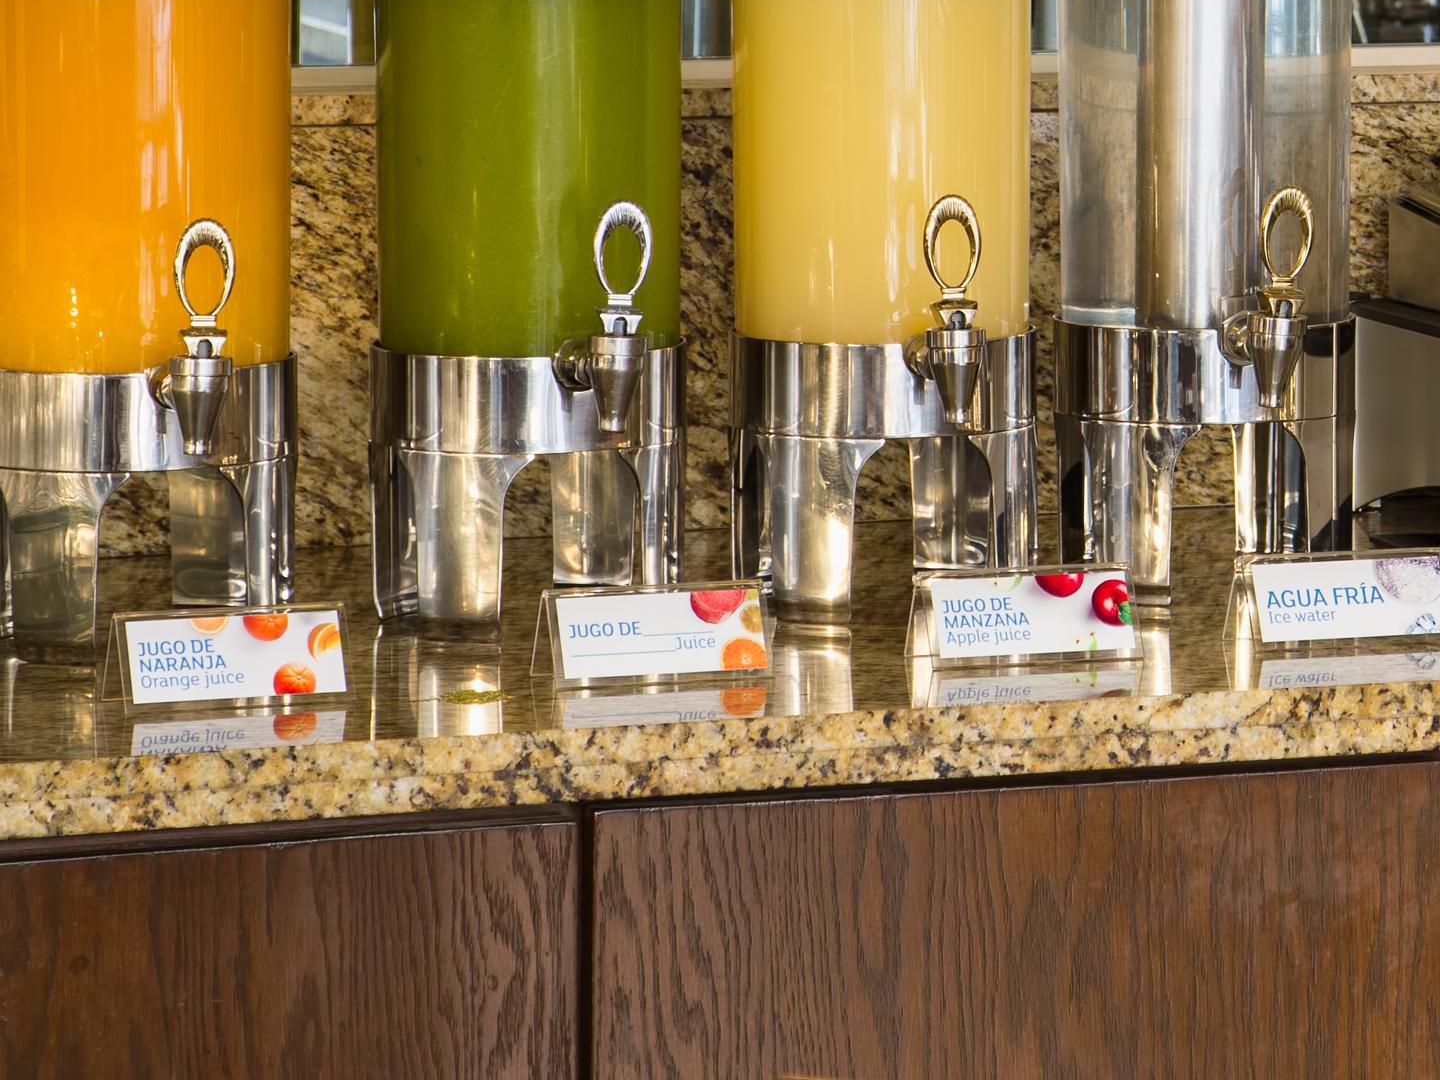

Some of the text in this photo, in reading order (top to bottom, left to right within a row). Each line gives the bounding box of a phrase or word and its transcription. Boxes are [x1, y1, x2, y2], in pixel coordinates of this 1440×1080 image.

[1267, 582, 1384, 608] AGUA FRÍA
[943, 597, 1012, 613] JUGO DE
[944, 612, 1029, 629] MANZANA
[1269, 609, 1335, 624] Ice water
[568, 621, 641, 638] JUGO DE
[947, 629, 1031, 647] Apple juice
[138, 638, 215, 656] JUGO DE
[676, 636, 716, 649] Juice
[139, 654, 227, 672] NARANJA
[141, 672, 244, 690] Orange juice
